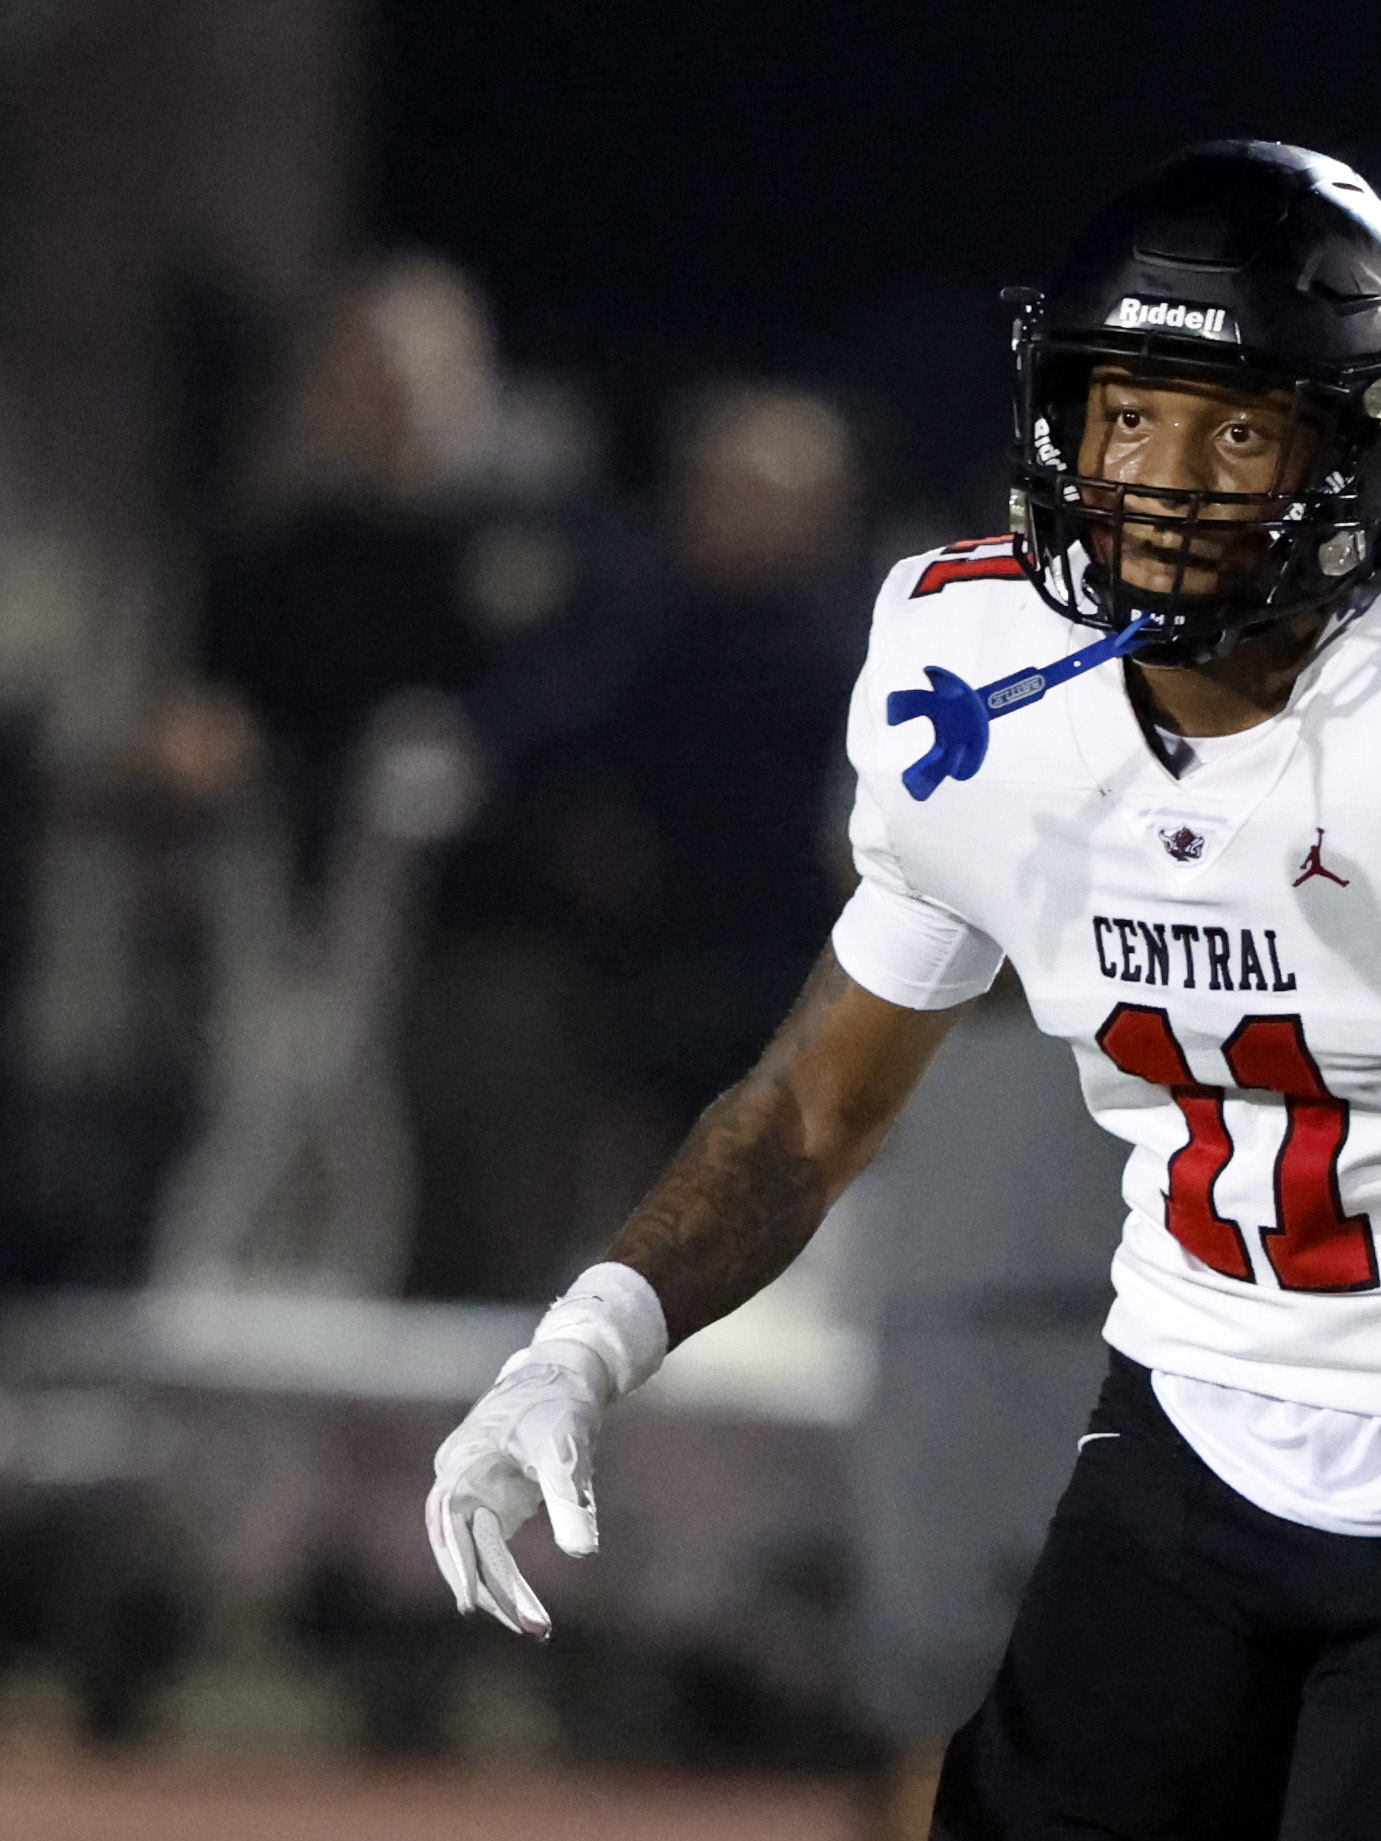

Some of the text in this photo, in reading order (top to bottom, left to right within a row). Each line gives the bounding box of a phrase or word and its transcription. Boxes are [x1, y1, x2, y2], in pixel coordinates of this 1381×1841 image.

[1119, 297, 1226, 332] Riddell
[1093, 915, 1298, 993] CENTRAL
[1095, 1001, 1381, 1292] 11
